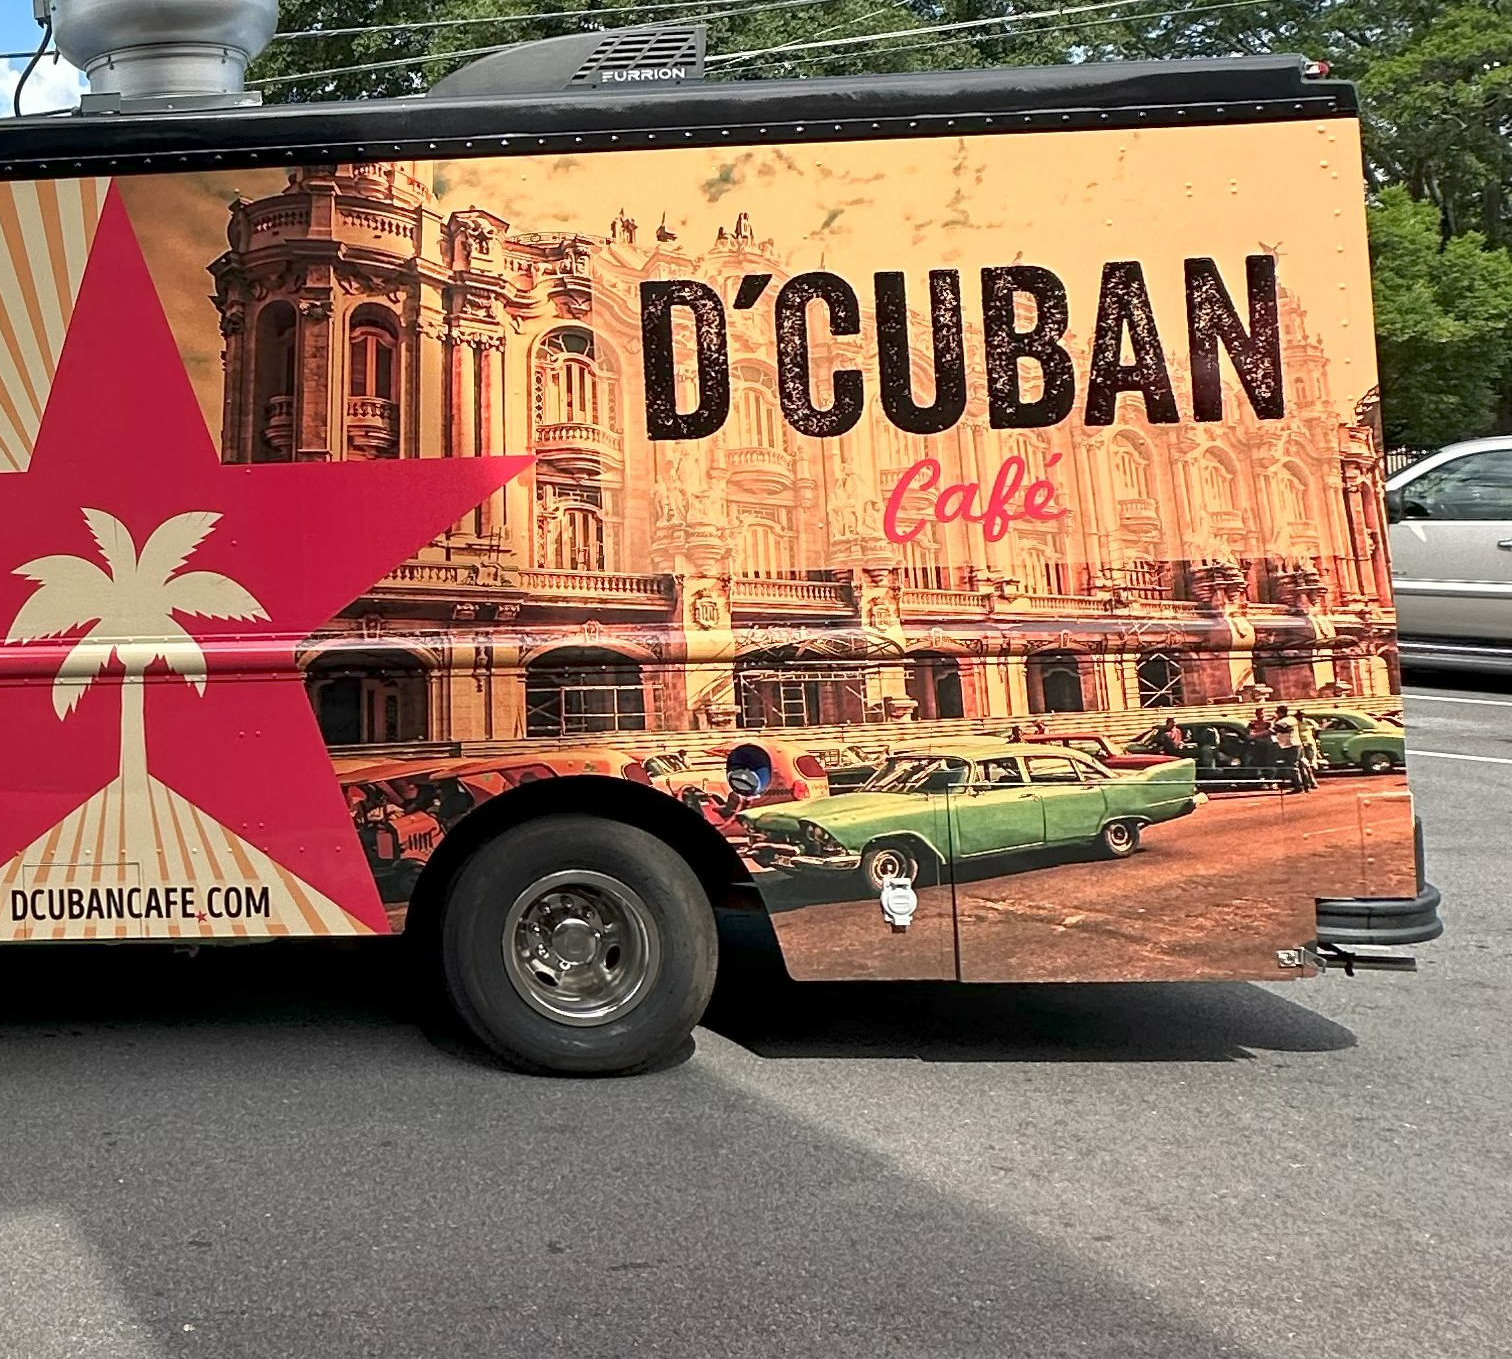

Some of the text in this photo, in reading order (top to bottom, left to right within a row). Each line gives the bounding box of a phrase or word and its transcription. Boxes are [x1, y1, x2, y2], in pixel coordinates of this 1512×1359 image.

[601, 67, 686, 83] FURRION
[638, 253, 1286, 442] D'CUBAN
[882, 451, 1070, 545] Café
